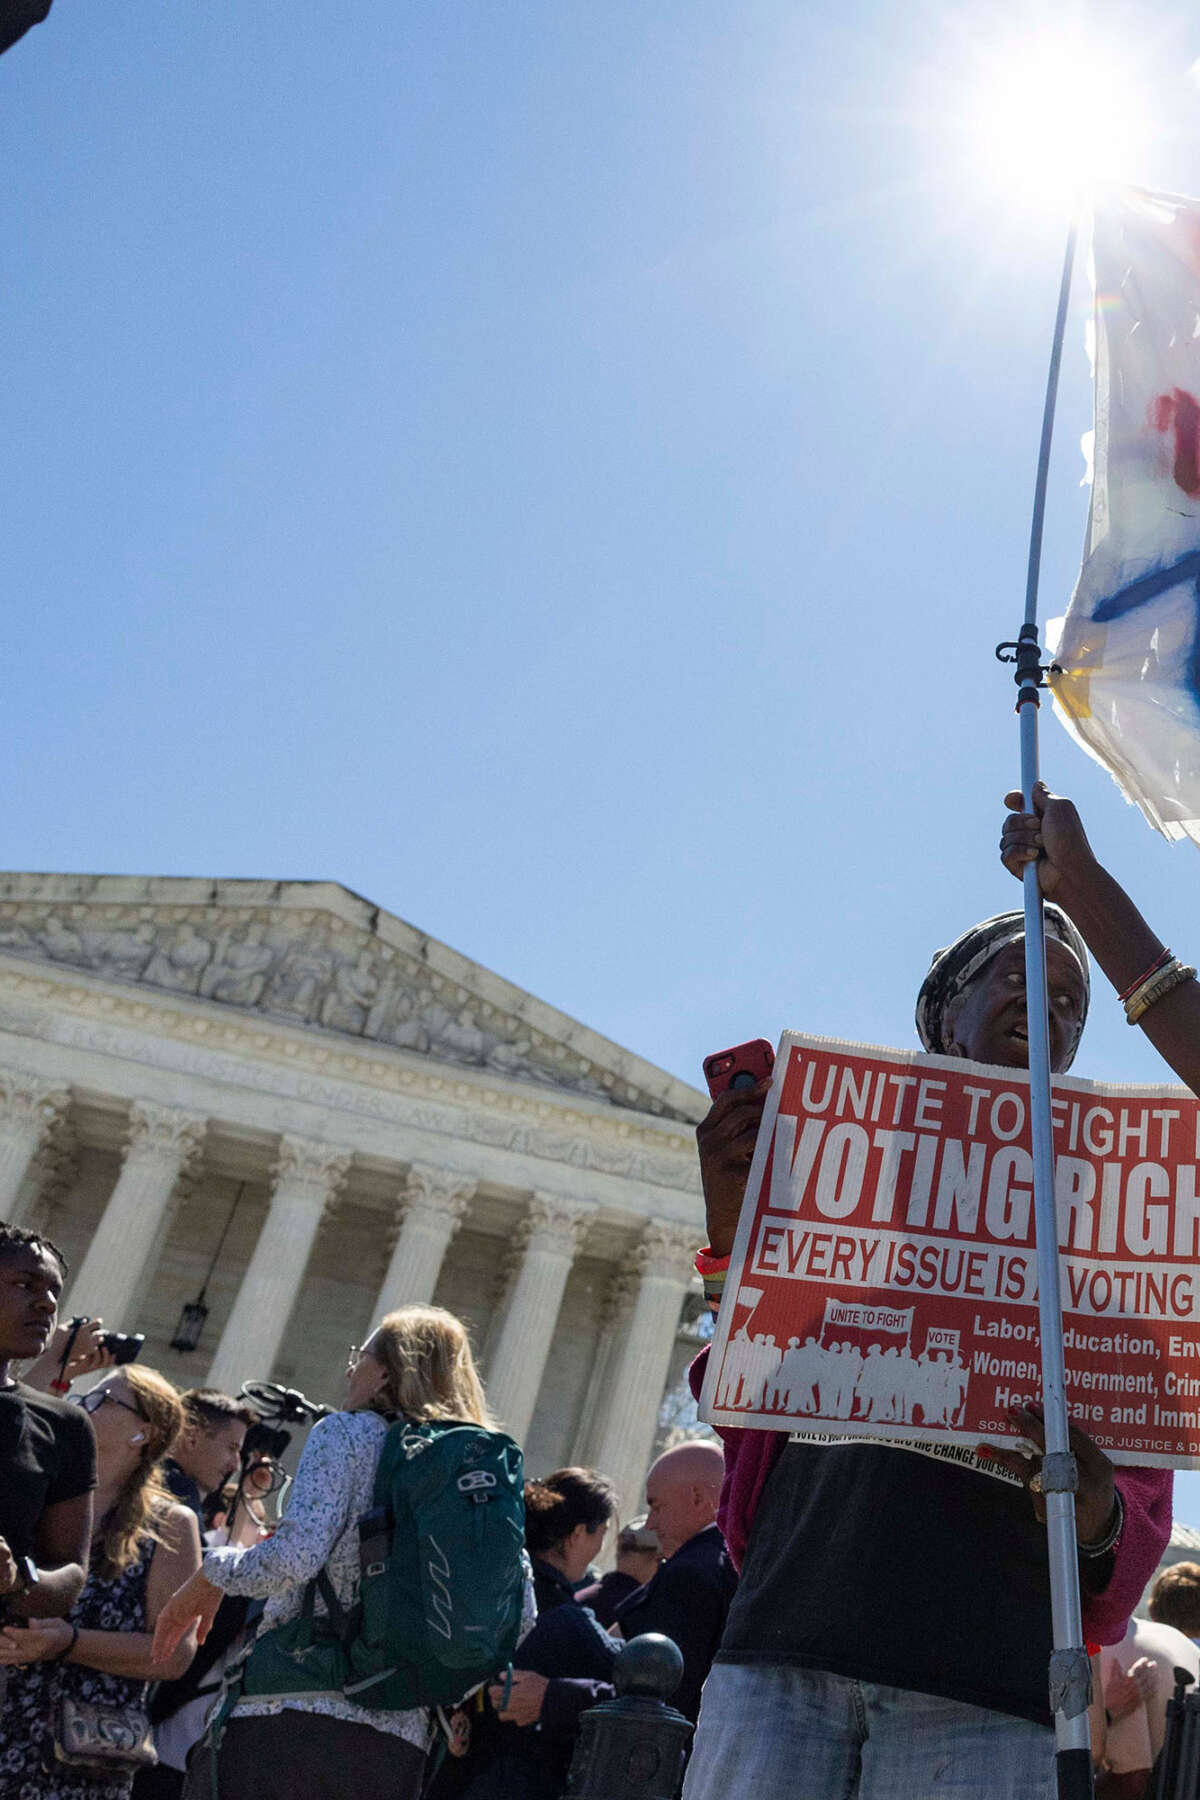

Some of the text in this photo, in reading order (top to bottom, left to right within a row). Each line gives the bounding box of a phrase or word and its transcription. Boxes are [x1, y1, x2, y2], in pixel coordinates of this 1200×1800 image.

[801, 1061, 947, 1131] UNITE
[962, 1085, 1025, 1141] TO
[1051, 1098, 1180, 1158] FIGHT
[768, 1113, 1034, 1241] VOTING
[757, 1226, 881, 1282] EVERY
[884, 1241, 989, 1296] ISSUE
[995, 1255, 1028, 1299] IS
[1066, 1265, 1193, 1316] VOTING
[830, 1309, 906, 1328] UNITE TO FIGHT
[973, 1315, 1040, 1348] Labor,
[1063, 1329, 1160, 1360] ducation,
[928, 1331, 956, 1345] VOTE
[973, 1351, 1042, 1384] Women,
[1063, 1369, 1158, 1399] overnment,
[1111, 1404, 1147, 1426] and
[978, 1420, 1006, 1432] SOS
[1117, 1438, 1172, 1451] JUSTICE
[1175, 1441, 1185, 1451] &
[933, 1444, 976, 1466] CHANGE
